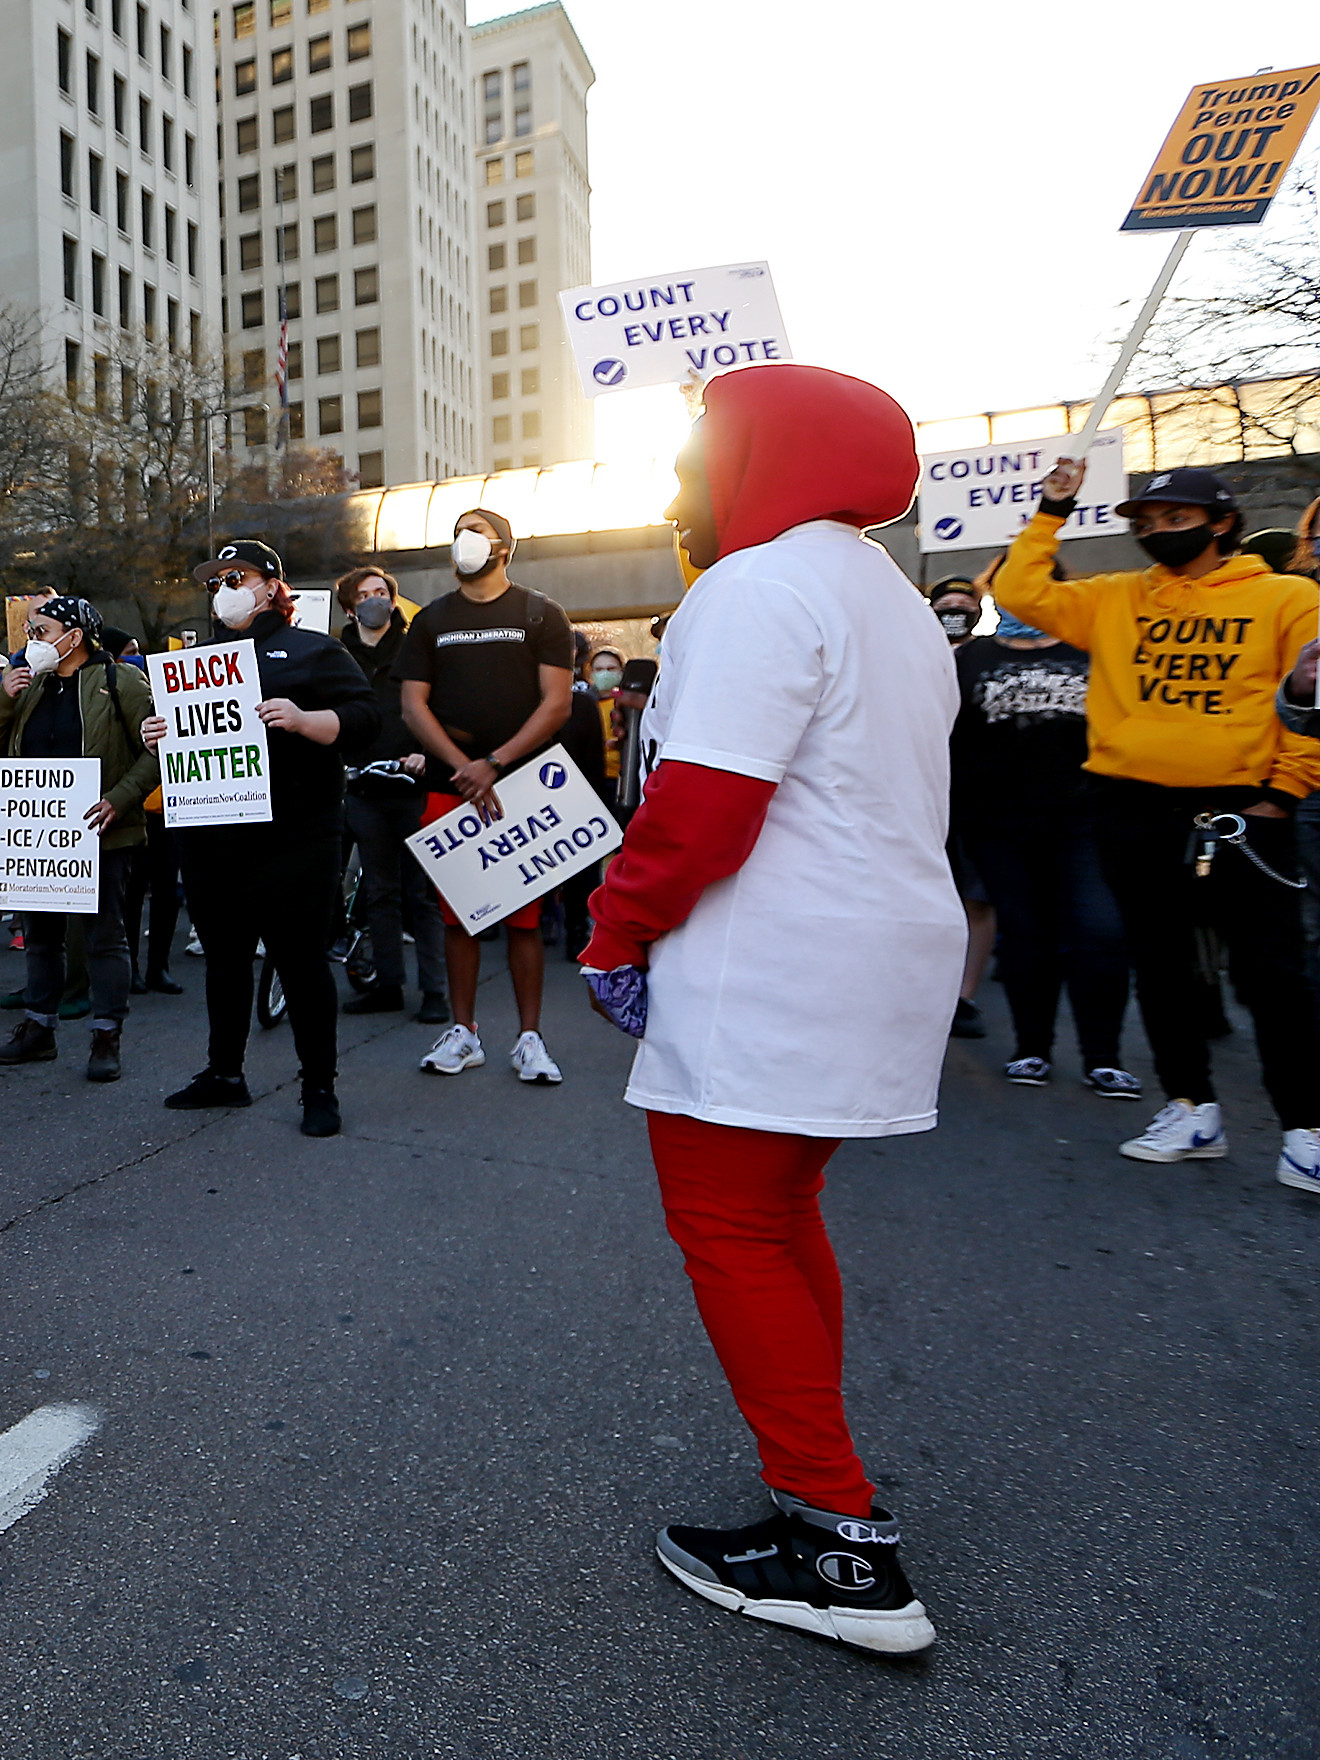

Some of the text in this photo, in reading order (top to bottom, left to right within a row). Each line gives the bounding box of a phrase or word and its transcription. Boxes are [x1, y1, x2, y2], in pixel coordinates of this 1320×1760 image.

[1198, 72, 1320, 109] Trump/
[1191, 102, 1298, 130] Pence
[1182, 124, 1285, 165] OUT
[1143, 161, 1284, 203] NOW!
[575, 280, 696, 321] COUNT
[624, 309, 731, 346] EVERY
[686, 338, 780, 370] VOTE
[930, 450, 1043, 481] COUNT
[163, 651, 244, 694] BLACK
[175, 699, 242, 738] LIVES
[1, 769, 75, 789] DEFUND
[166, 744, 262, 785] MATTER
[0, 799, 67, 818] -POLICE
[0, 829, 32, 847] -ICE
[48, 829, 82, 848] CBP
[477, 803, 564, 871] EVERY
[517, 816, 609, 886] COUNT
[0, 858, 92, 878] -PENTAGON
